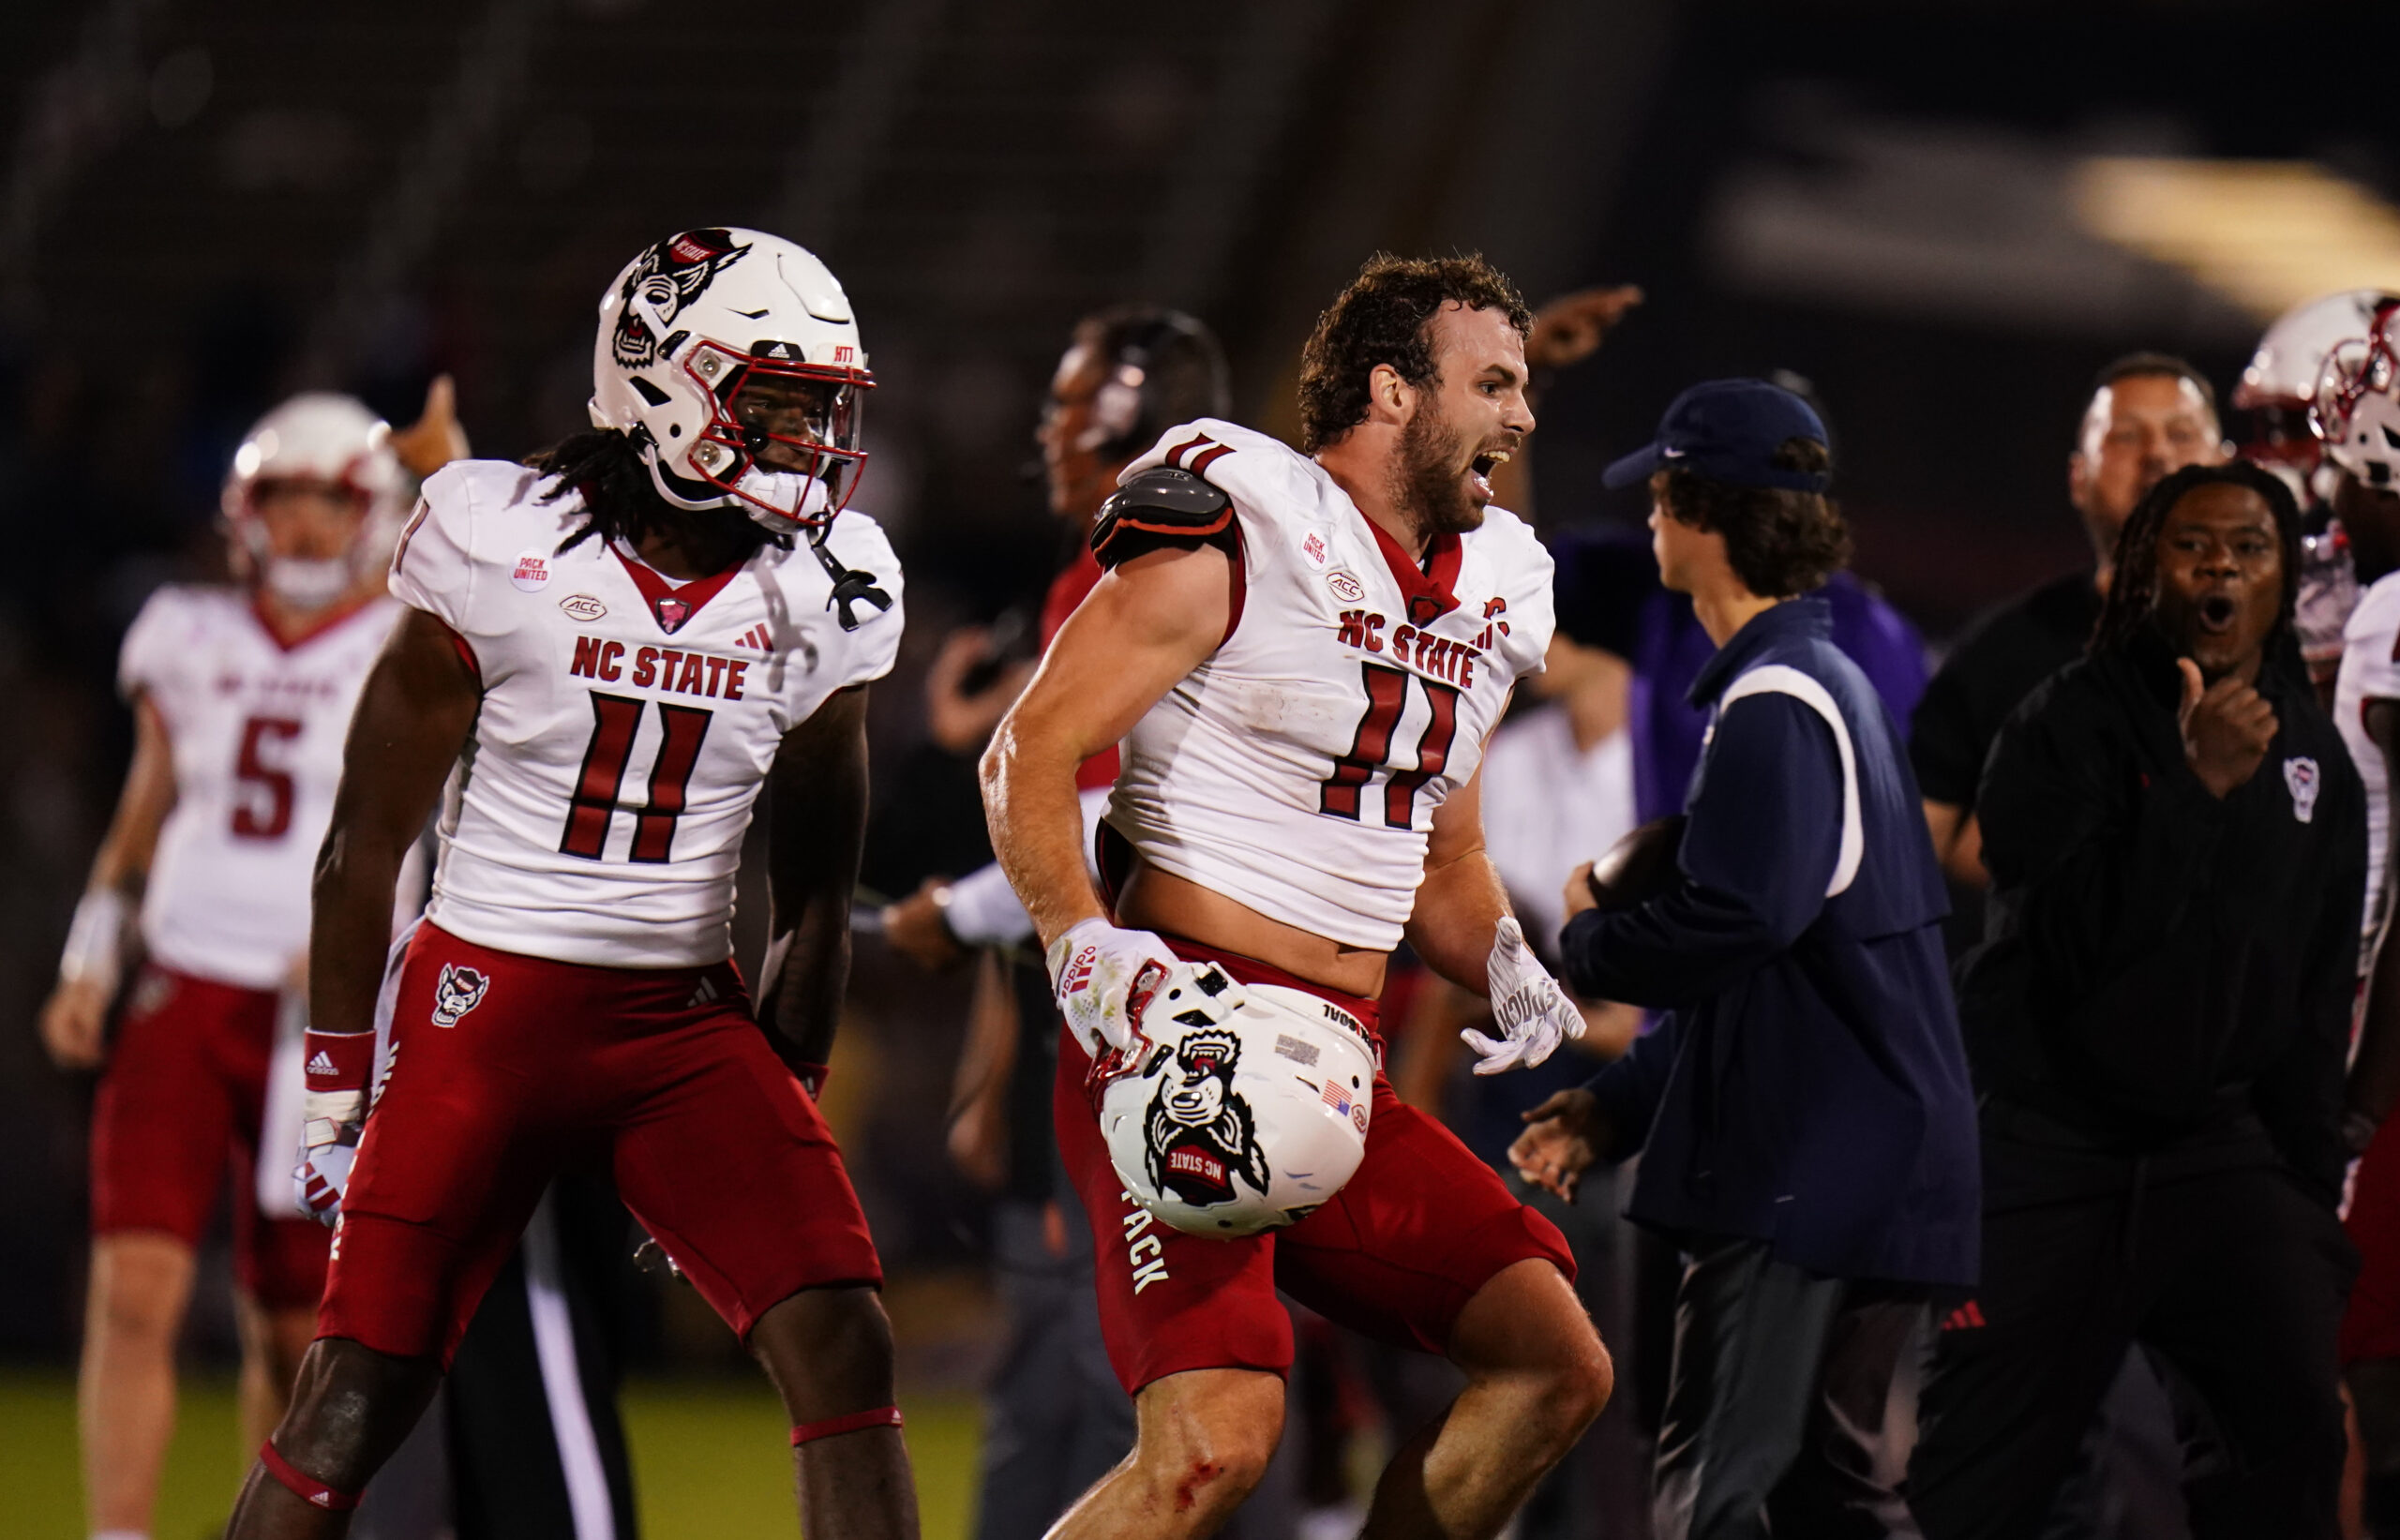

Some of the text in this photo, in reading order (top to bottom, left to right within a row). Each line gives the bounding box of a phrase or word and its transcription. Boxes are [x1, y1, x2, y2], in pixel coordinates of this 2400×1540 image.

[680, 245, 711, 262] STATE
[1303, 540, 1326, 564] UNITED
[1308, 532, 1326, 552] PACK
[513, 567, 548, 581] UNITED
[519, 557, 546, 570] PACK
[1331, 577, 1360, 596] ACC
[566, 600, 601, 614] ACC
[1338, 608, 1483, 690] NC STATE
[569, 635, 750, 702] NC STATE
[1319, 660, 1461, 831] 11
[231, 715, 303, 841] 5
[558, 689, 714, 865] 11
[1061, 946, 1097, 1000] adidas
[1170, 1152, 1222, 1181] NC STATE
